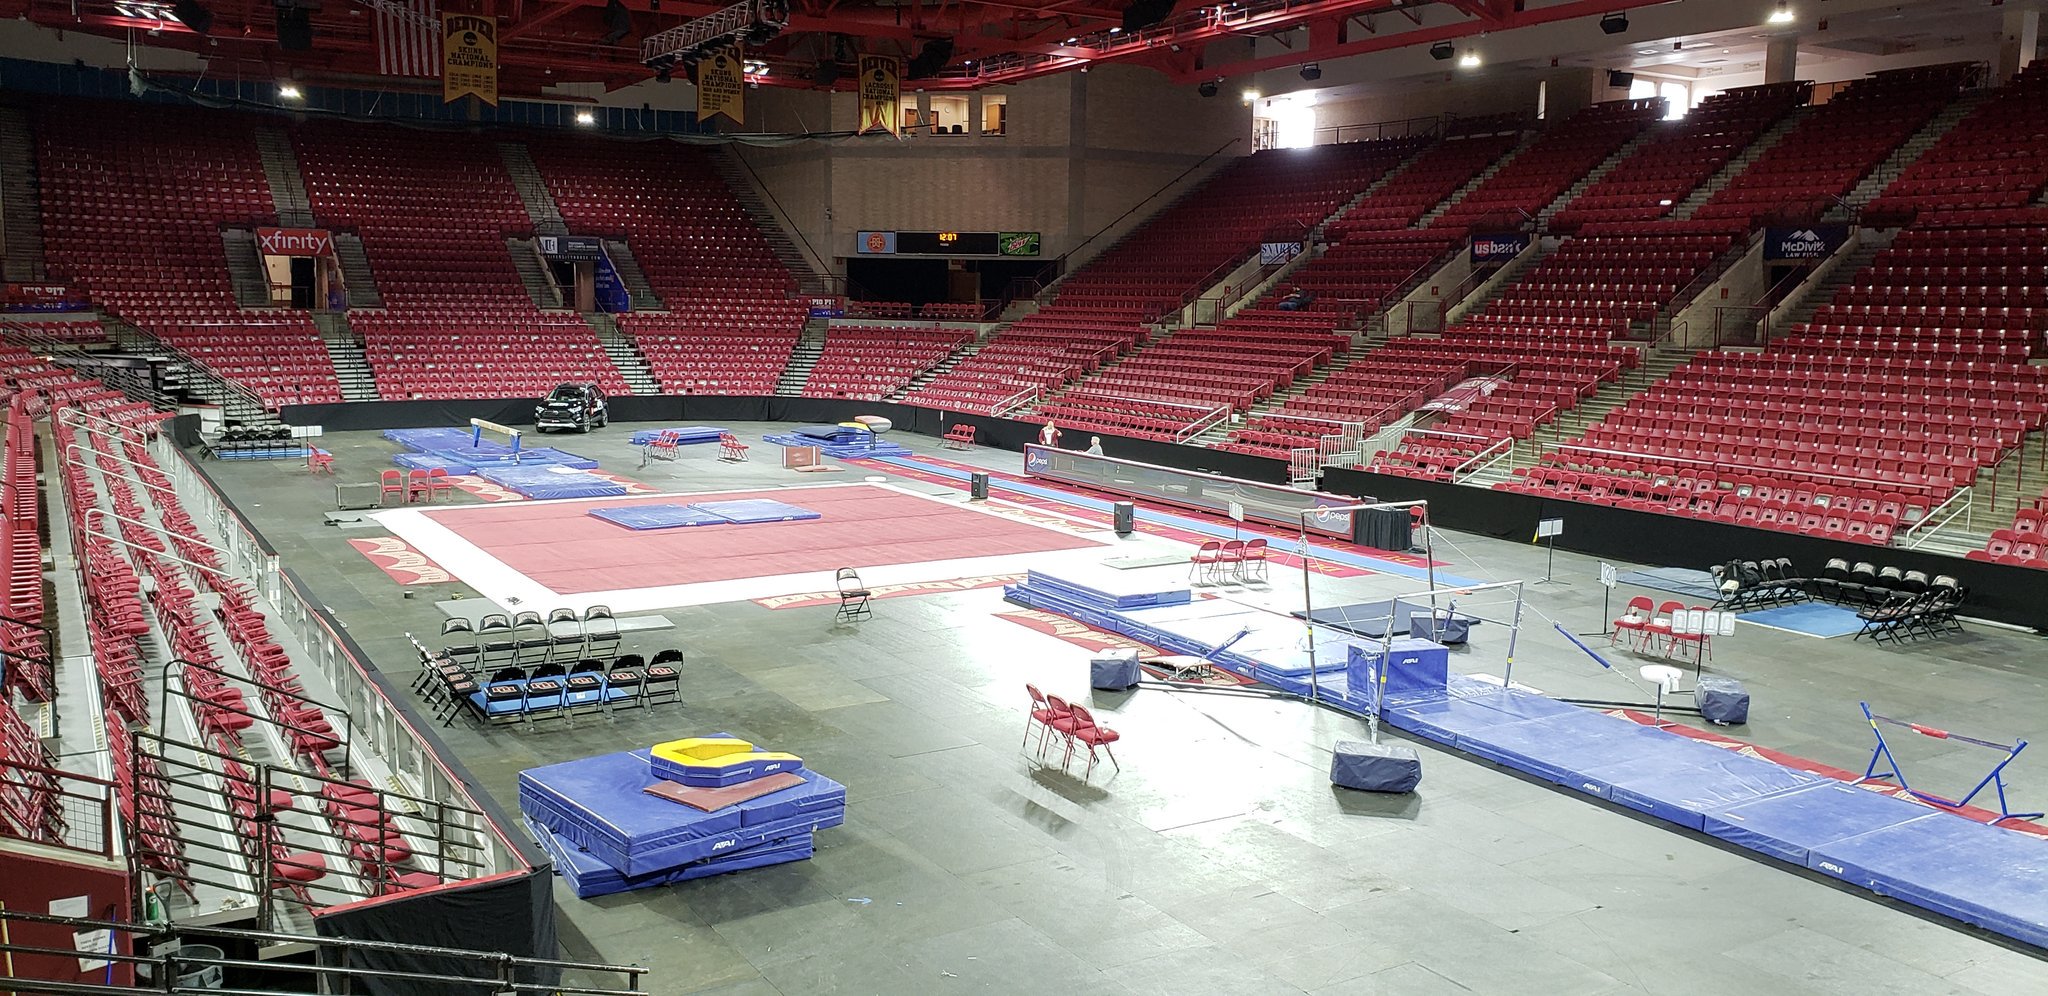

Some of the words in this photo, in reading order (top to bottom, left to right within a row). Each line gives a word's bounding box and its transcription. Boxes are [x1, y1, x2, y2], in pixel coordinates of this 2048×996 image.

[446, 15, 495, 44] DENVER
[447, 58, 494, 69] CHAMPIONS
[451, 52, 490, 62] NATIONAL
[260, 230, 328, 254] xfinity
